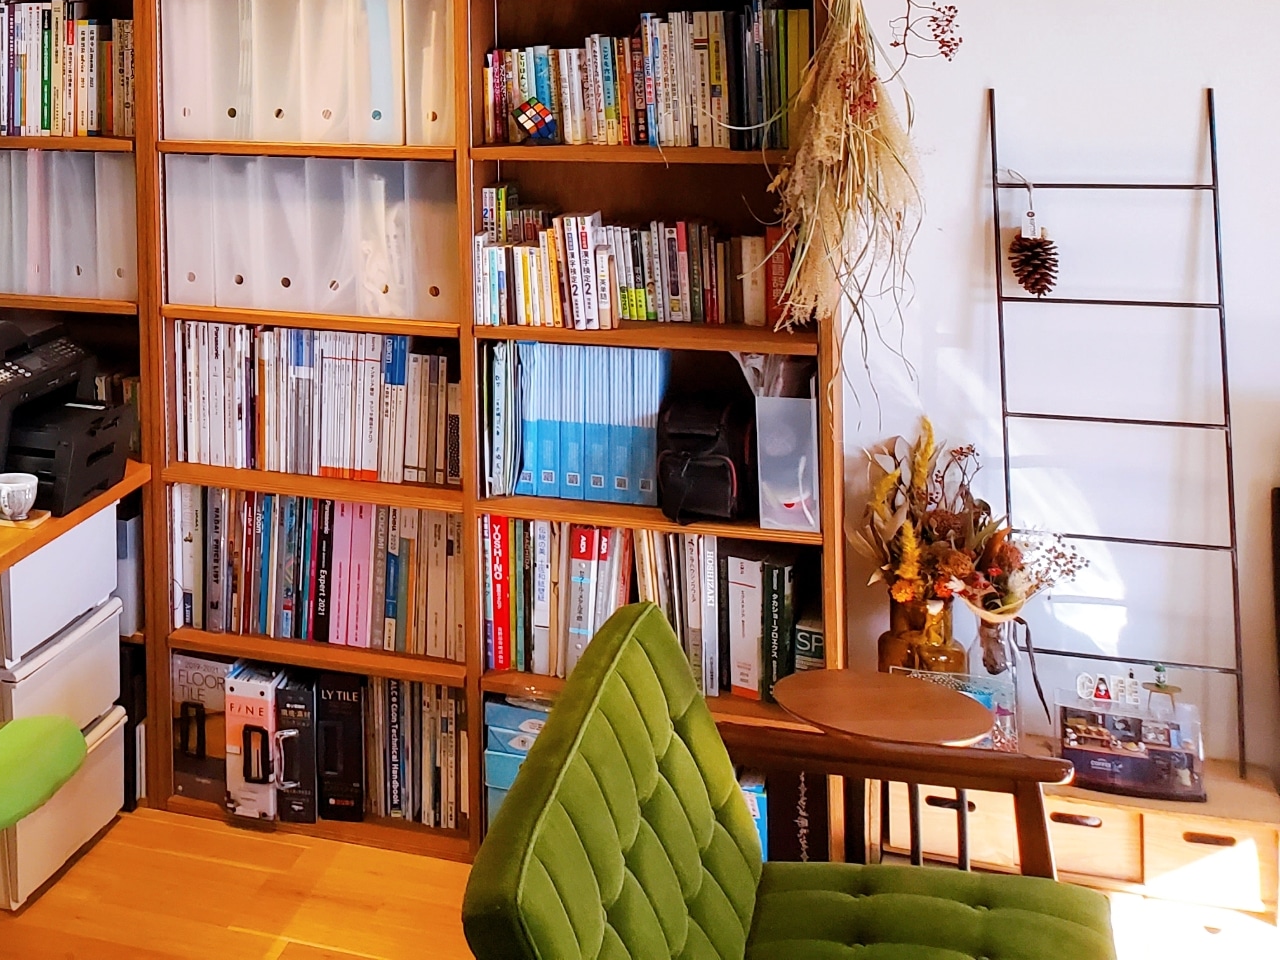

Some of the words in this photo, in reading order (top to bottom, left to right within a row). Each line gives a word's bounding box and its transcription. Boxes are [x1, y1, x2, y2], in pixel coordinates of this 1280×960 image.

[483, 208, 488, 219] 2
[489, 208, 494, 219] 1
[323, 499, 332, 535] Panasonic
[377, 508, 386, 549] KOIZUMI
[493, 524, 503, 580] YOSHINO
[318, 569, 328, 597] Expert
[706, 550, 715, 607] HOSHIZAKI
[317, 597, 326, 616] 2021
[178, 669, 225, 691] FLOOR
[179, 684, 206, 703] TILE
[1077, 672, 1140, 705] CAFE
[230, 702, 265, 717] FINE
[336, 690, 359, 702] TILE
[391, 724, 399, 762] Technical
[392, 763, 400, 805] Handbook
